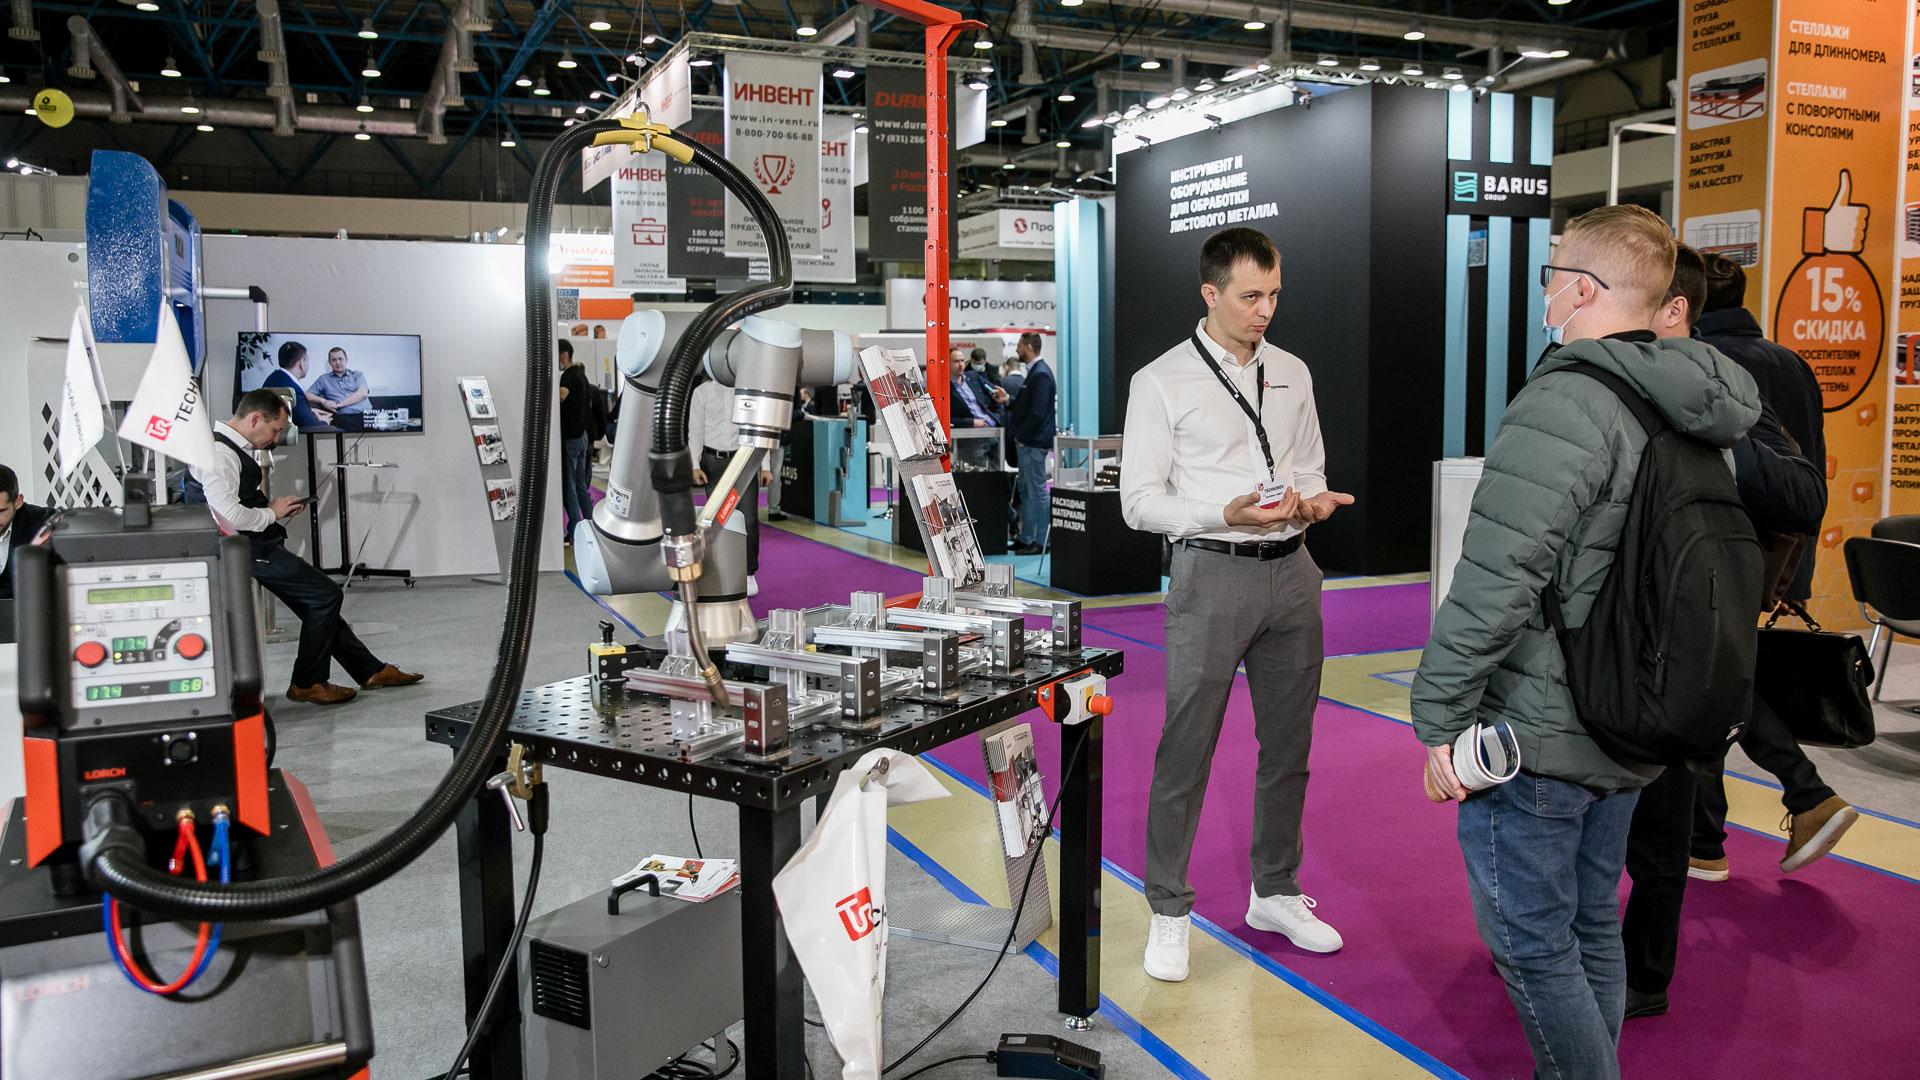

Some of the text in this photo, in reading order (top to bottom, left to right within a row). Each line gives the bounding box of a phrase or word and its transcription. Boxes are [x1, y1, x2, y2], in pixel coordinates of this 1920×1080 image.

[1693, 11, 1719, 25] ГРУЗА
[1693, 20, 1735, 39] В ОДНОМ
[1789, 20, 1850, 39] СТЕЛЛАЖИ
[1692, 32, 1741, 52] СТЕЛЛАЖЕ
[1788, 41, 1887, 64] ДЛЯ ДЛИННОМЕРА
[734, 82, 814, 106] ИНВЕНТ
[1787, 82, 1847, 100] СТЕЛЛАЖИ
[1786, 102, 1880, 123] С ПОВОРОТНЫМИ
[730, 114, 819, 127] www.in-vent.ru
[875, 120, 927, 129] www.durm
[736, 128, 813, 141] 8-800-700-66-88
[1785, 122, 1854, 140] КОНСОЛЯМИ
[1689, 136, 1731, 151] БЫСТРАЯ
[1689, 149, 1732, 165] ЗАГРУЗКА
[619, 168, 666, 182] ИНВЕН
[1170, 155, 1243, 183] ИНСТРУМЕНТ И
[1688, 164, 1725, 178] ЛИСТОВ
[1170, 171, 1248, 200] ОБОРУДОВАНИЕ
[1484, 175, 1549, 195] BARUS
[1688, 174, 1744, 190] НА КАССЕТУ
[1170, 189, 1250, 219] ДЛЯ ОБРАБОТКИ
[1483, 193, 1508, 201] GROUP
[1170, 202, 1279, 234] ЛИСТОВОГО МЕТАЛЛА
[692, 229, 707, 237] 180
[897, 224, 928, 232] станко
[1031, 222, 1054, 232] Про
[687, 246, 711, 254] всему
[1806, 266, 1861, 313] 15%
[949, 296, 1056, 311] ПроТехнологи
[1793, 319, 1866, 344] СКИДКА
[1819, 382, 1849, 392] СТЕМЫ
[720, 494, 736, 519] LORCH
[1052, 496, 1086, 510] РАСХОДНЫЕ
[1052, 507, 1086, 521] МАТЕРИАЛЫ
[1052, 518, 1086, 532] ДЛЯ ЛАЗЕРА
[83, 767, 126, 781] LORCH
